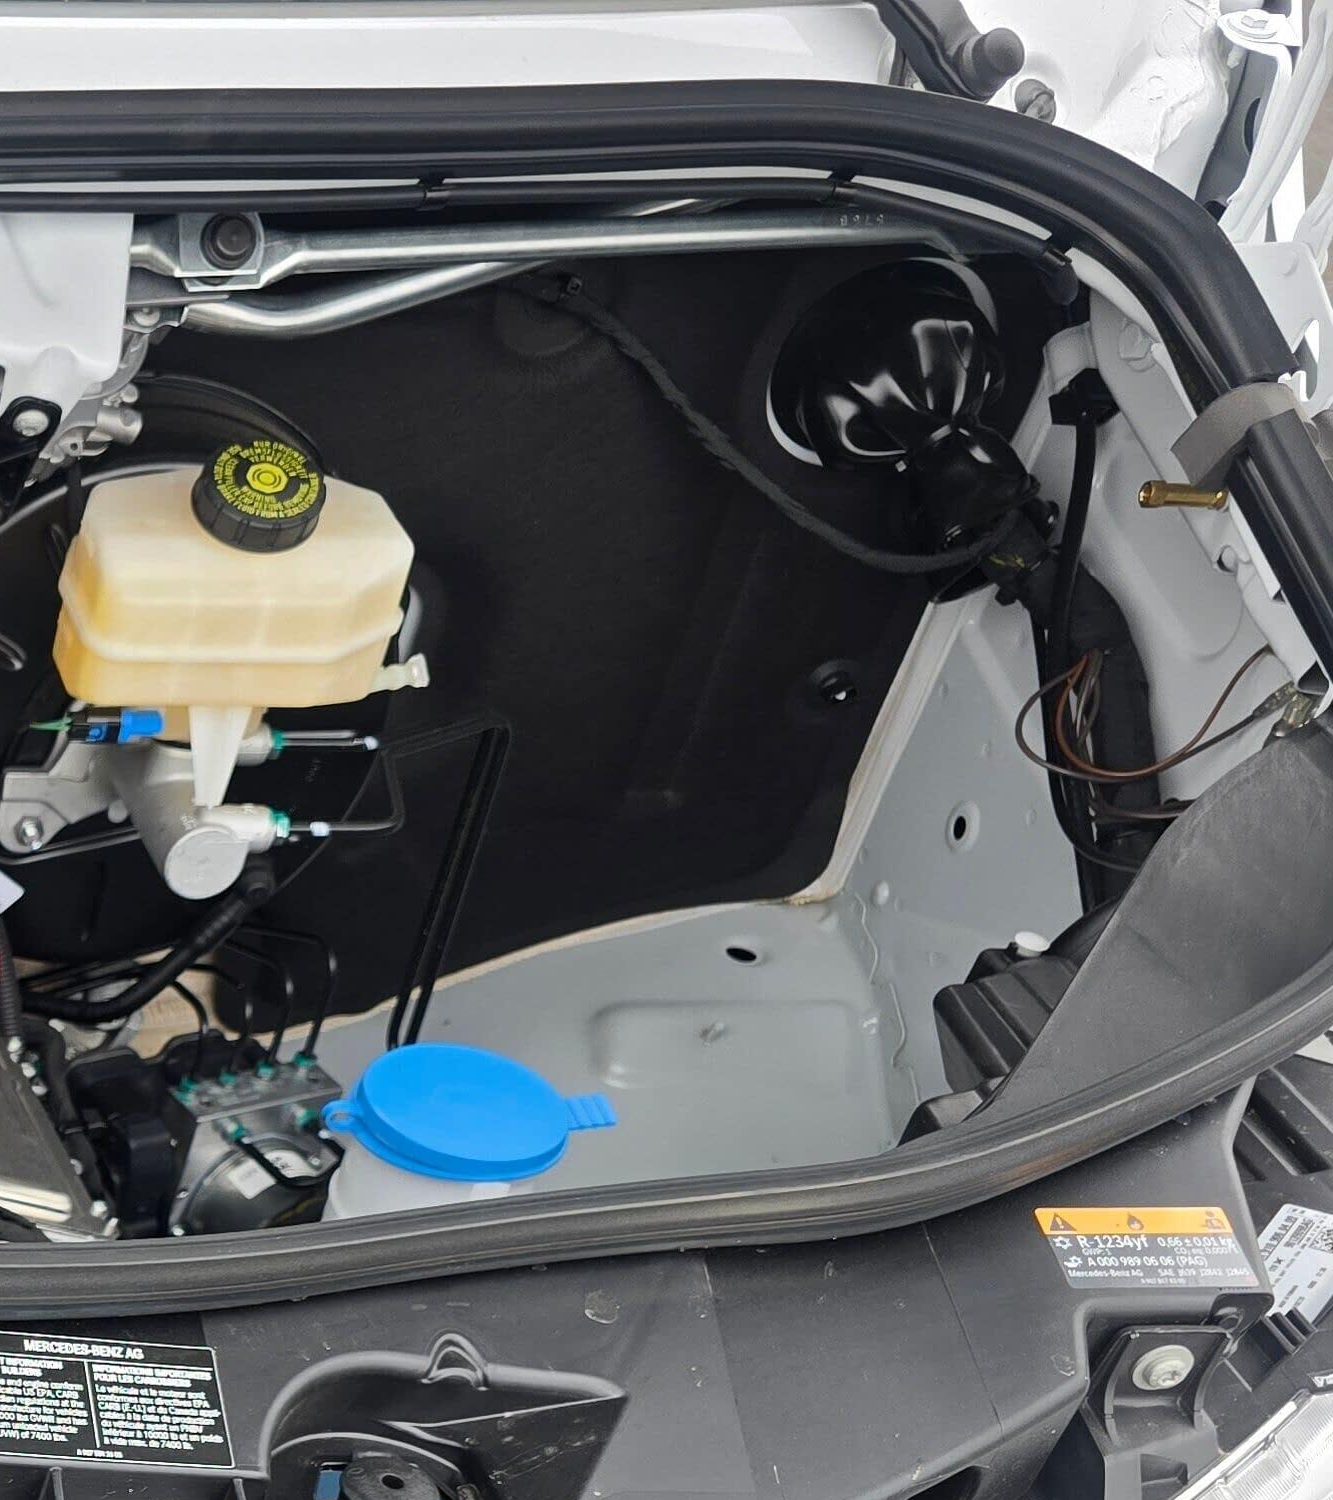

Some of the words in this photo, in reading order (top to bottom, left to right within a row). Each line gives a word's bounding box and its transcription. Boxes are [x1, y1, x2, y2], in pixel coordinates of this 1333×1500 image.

[1077, 1235, 1148, 1250] R-1234yf
[1088, 1257, 1096, 1266] A
[1097, 1257, 1119, 1266] 000
[1121, 1257, 1141, 1266] 989
[1145, 1257, 1160, 1266] 06
[1161, 1257, 1175, 1266] 06
[1176, 1256, 1208, 1267] (PAG)
[1068, 1269, 1130, 1278] Mercedes-Benz
[23, 1340, 124, 1358] MERCEDES-BENZ
[125, 1348, 144, 1359] AG
